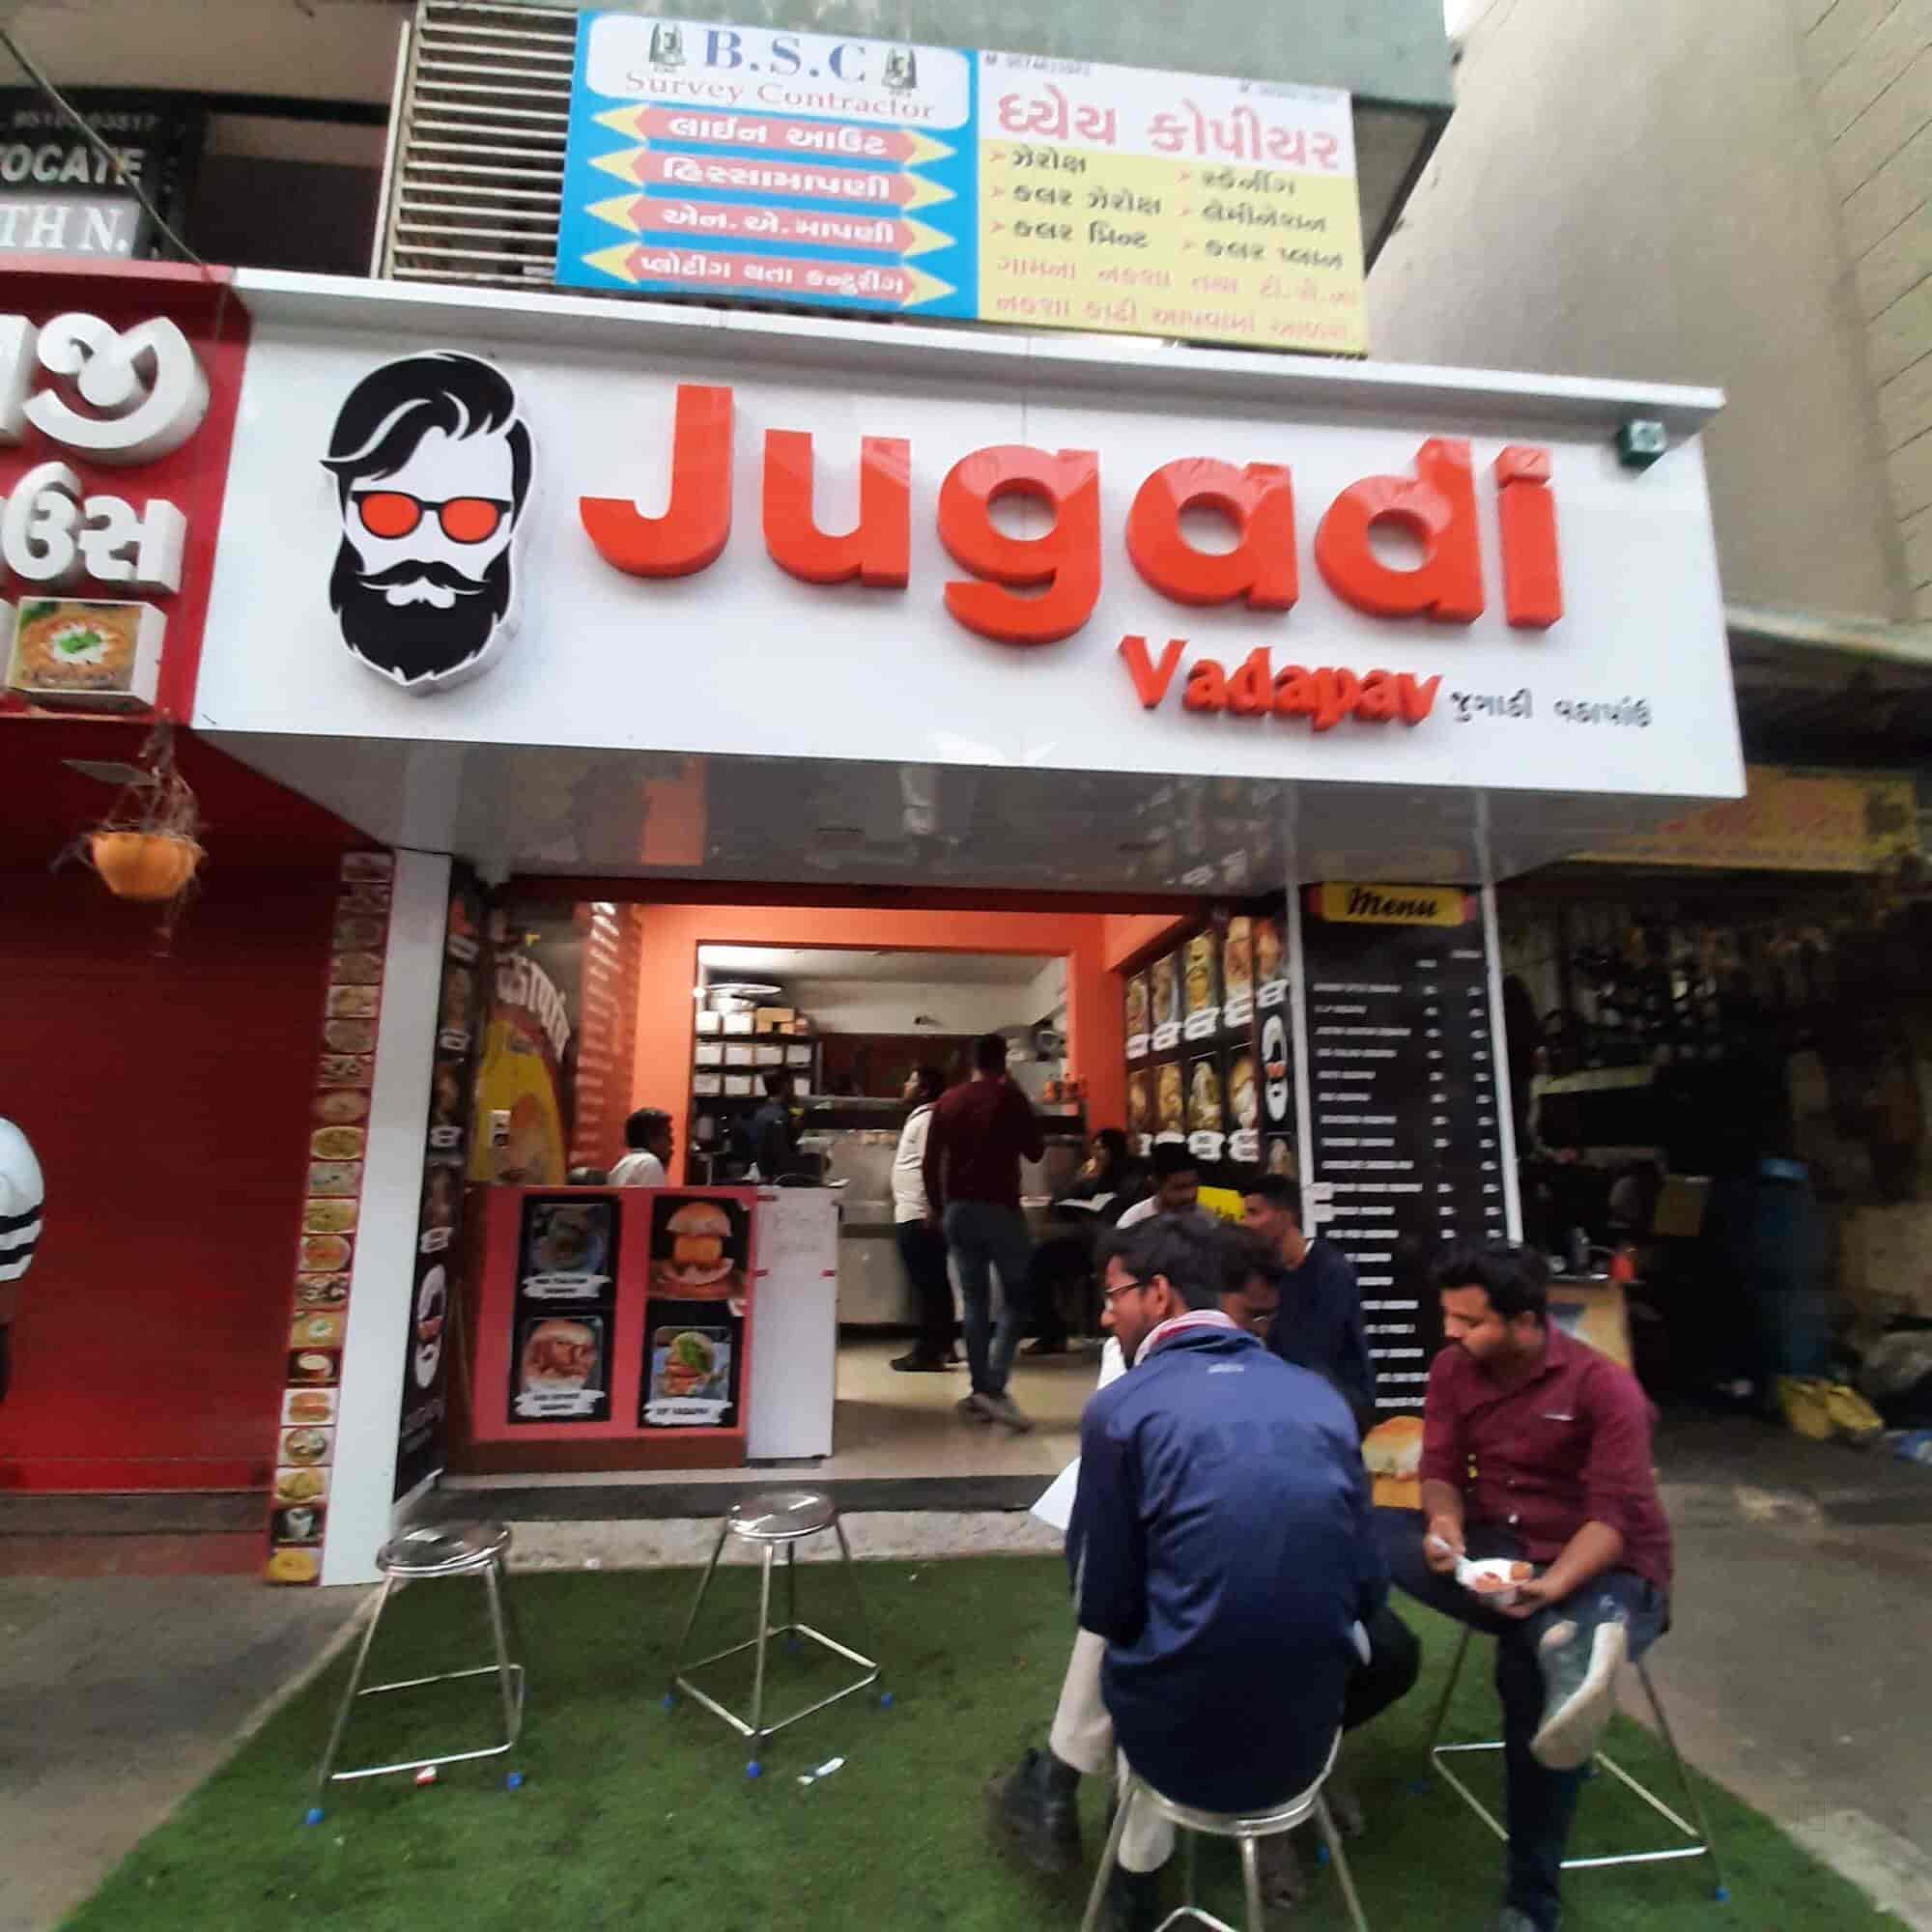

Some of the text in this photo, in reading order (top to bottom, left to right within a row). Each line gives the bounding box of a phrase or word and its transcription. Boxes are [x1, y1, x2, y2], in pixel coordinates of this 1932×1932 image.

[702, 28, 867, 85] B.S.C
[625, 70, 934, 120] Survey Contractor
[579, 383, 1565, 645] Jugadi
[1117, 634, 1443, 731] Vadapav
[1346, 887, 1438, 919] Menu
